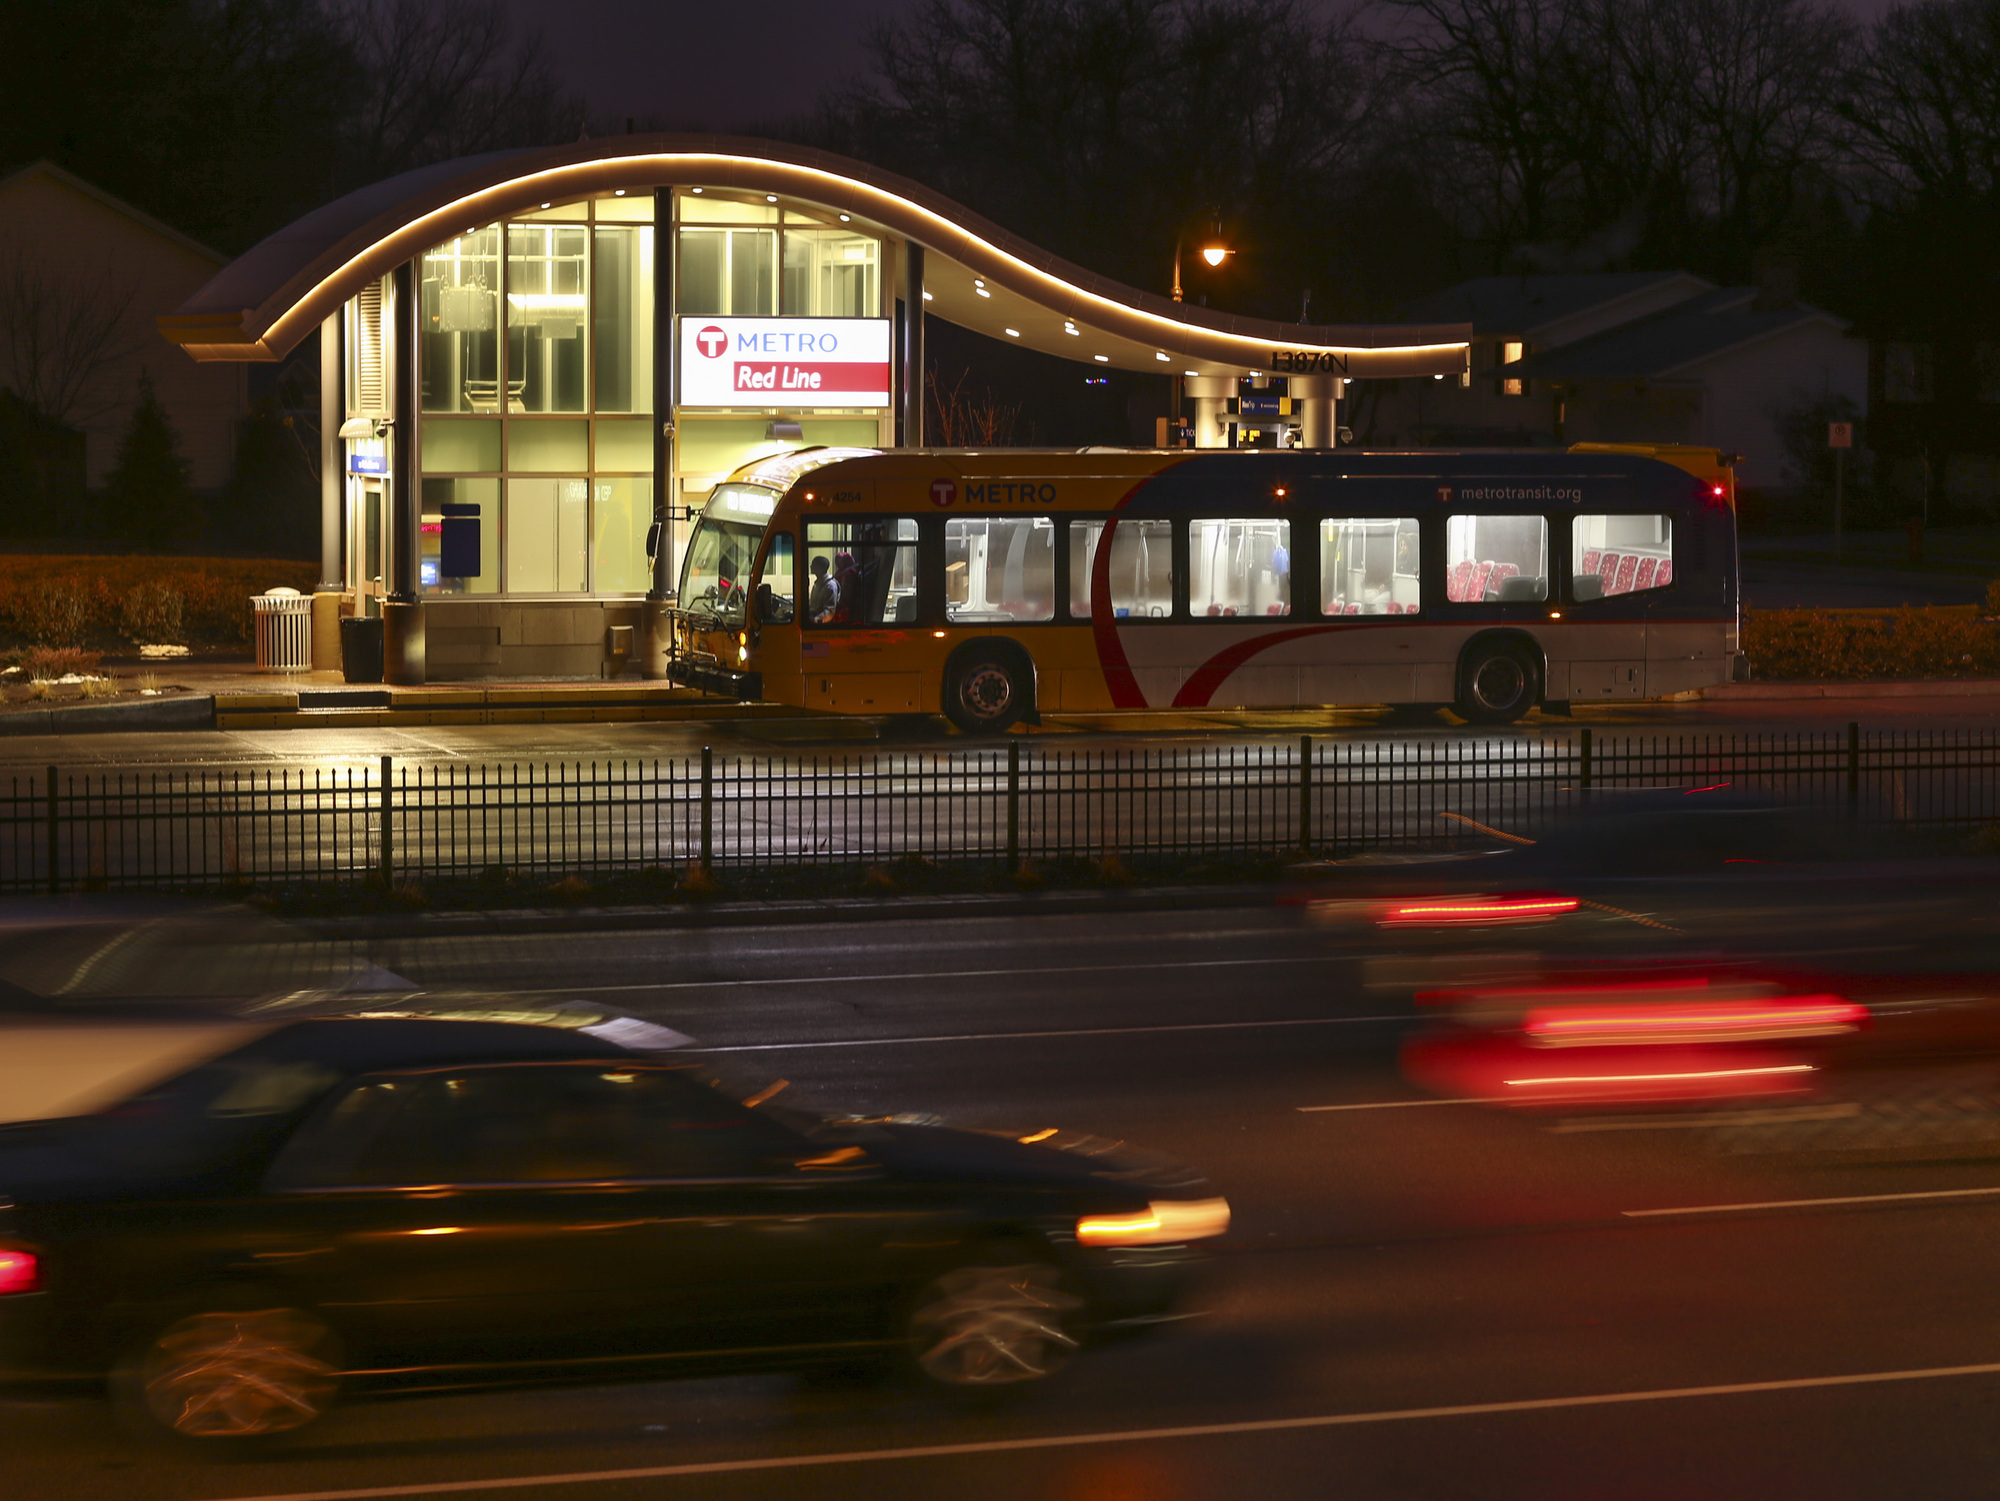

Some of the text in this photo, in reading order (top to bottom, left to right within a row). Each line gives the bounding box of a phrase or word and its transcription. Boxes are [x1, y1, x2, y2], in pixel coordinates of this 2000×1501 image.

[737, 332, 838, 352] METRO
[738, 366, 821, 388] Red Line
[965, 483, 1057, 504] METRO
[1461, 485, 1582, 503] metrotransit.org
